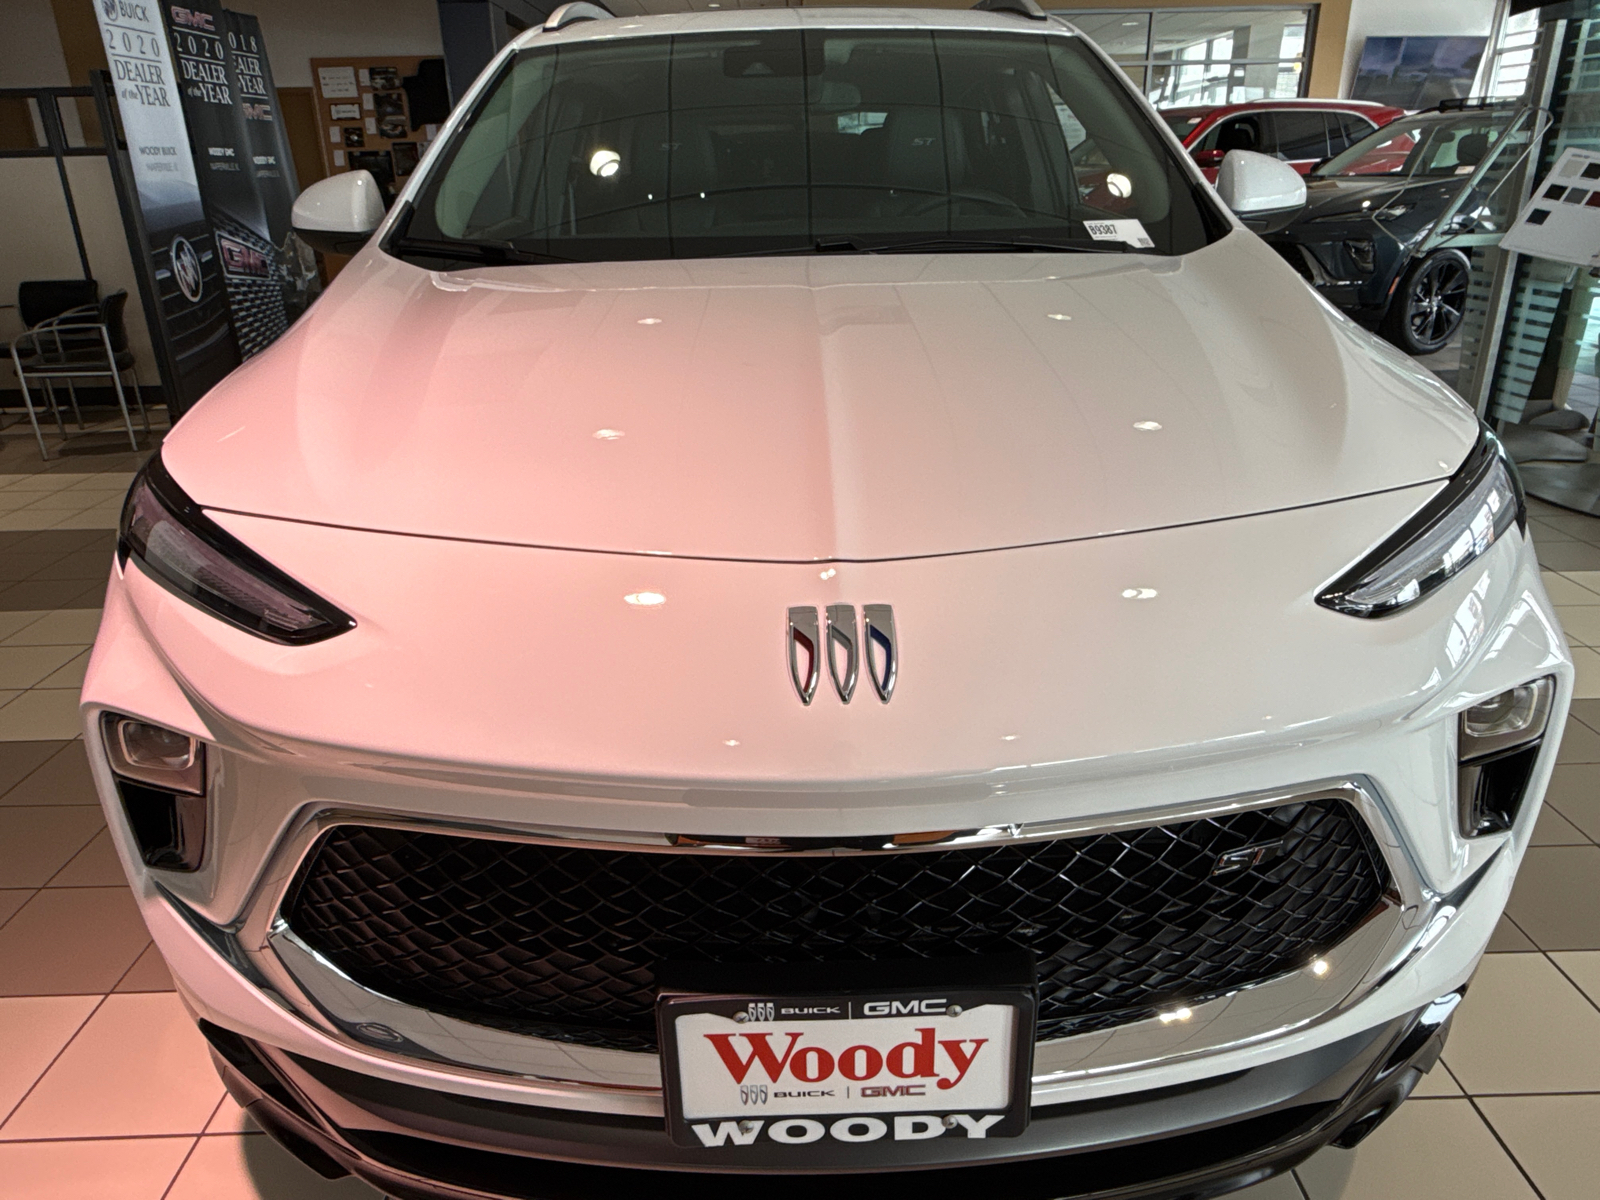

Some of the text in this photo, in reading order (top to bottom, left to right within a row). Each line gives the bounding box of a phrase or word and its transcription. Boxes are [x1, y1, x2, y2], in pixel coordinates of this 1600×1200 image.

[119, 1, 149, 22] BUICK
[170, 5, 215, 31] GMC
[106, 29, 160, 57] 2020
[174, 32, 224, 59] 2020
[228, 32, 257, 53] 018
[114, 59, 166, 85] DEALER
[180, 59, 228, 85] DEALER
[233, 55, 263, 76] ALER
[135, 84, 171, 107] YEAR
[199, 83, 233, 105] YEAR
[238, 75, 267, 95] YEAR
[781, 999, 947, 1016] BUICK GMC
[703, 1027, 989, 1090] Woody
[773, 1084, 926, 1098] BUICK GMC
[691, 1114, 1005, 1147] WOODY
